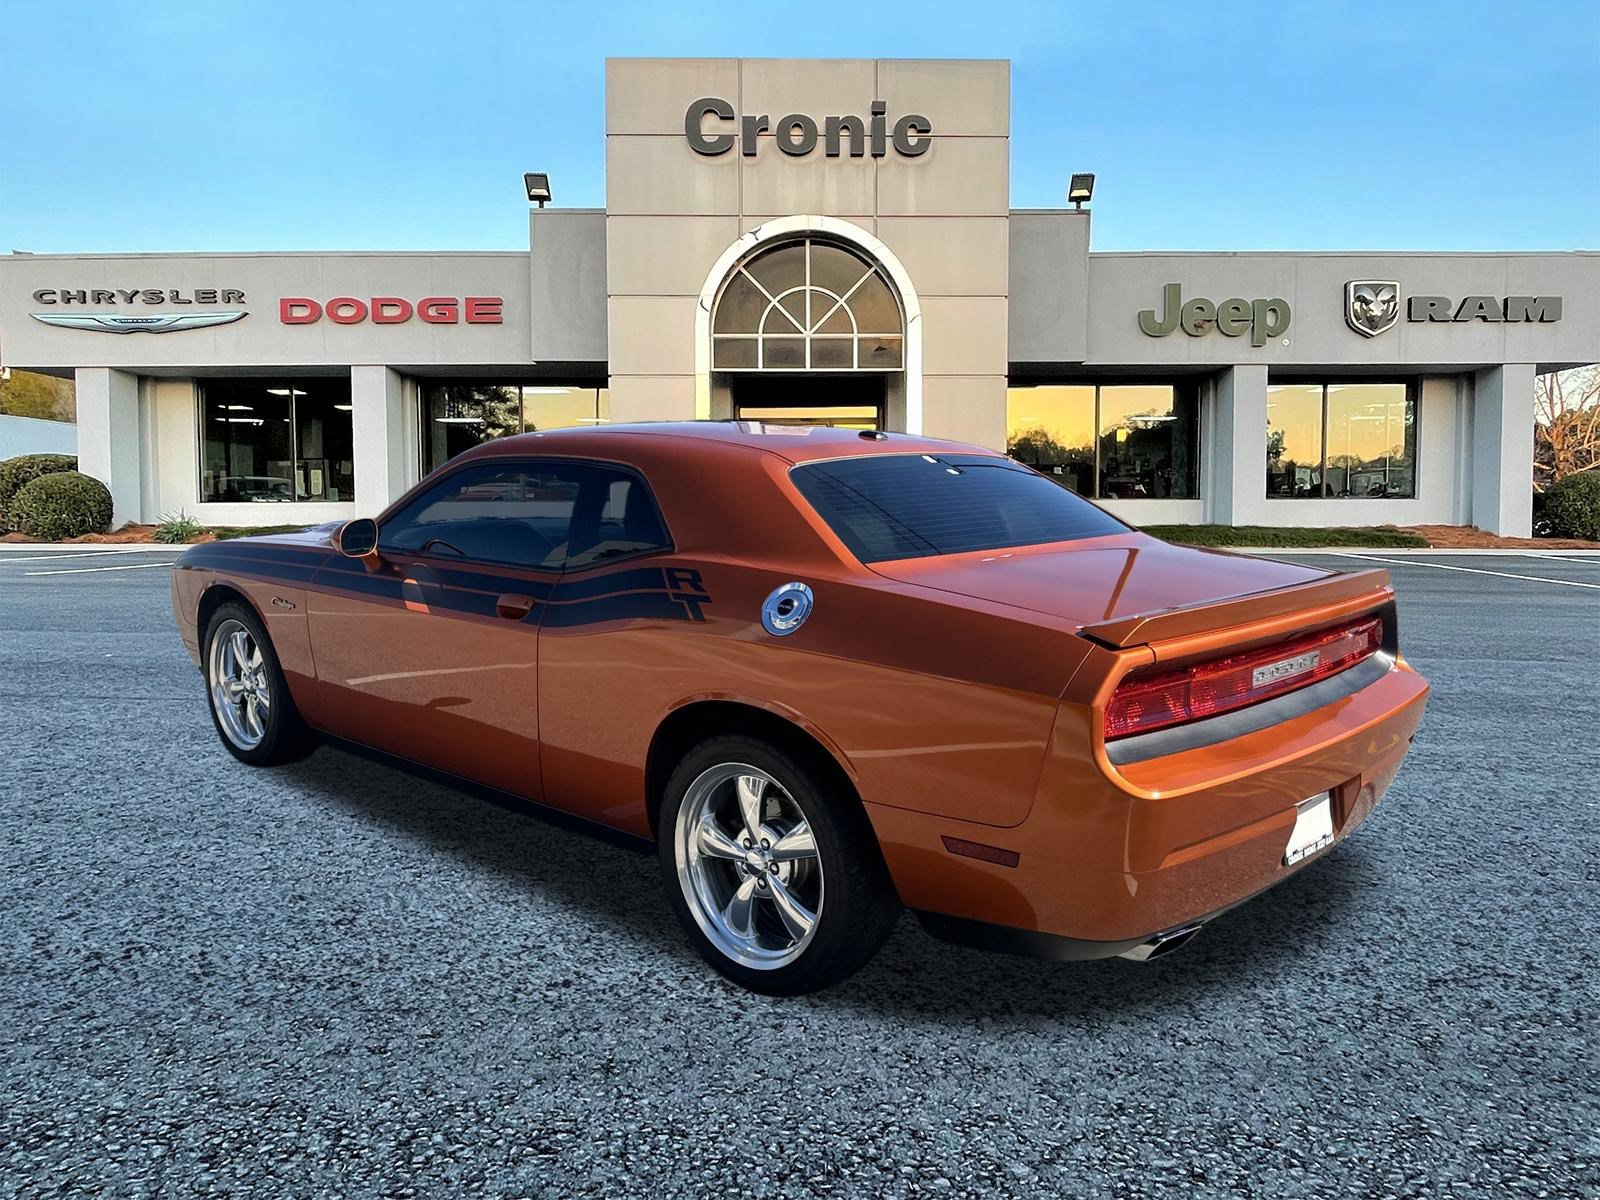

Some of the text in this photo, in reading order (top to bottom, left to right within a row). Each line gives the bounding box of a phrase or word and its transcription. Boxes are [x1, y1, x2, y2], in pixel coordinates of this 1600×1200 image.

[685, 97, 932, 157] Cronic
[33, 289, 246, 304] CHRYSLER
[1407, 296, 1563, 322] RAM
[280, 297, 503, 324] DODGE
[1138, 283, 1291, 347] Jeep
